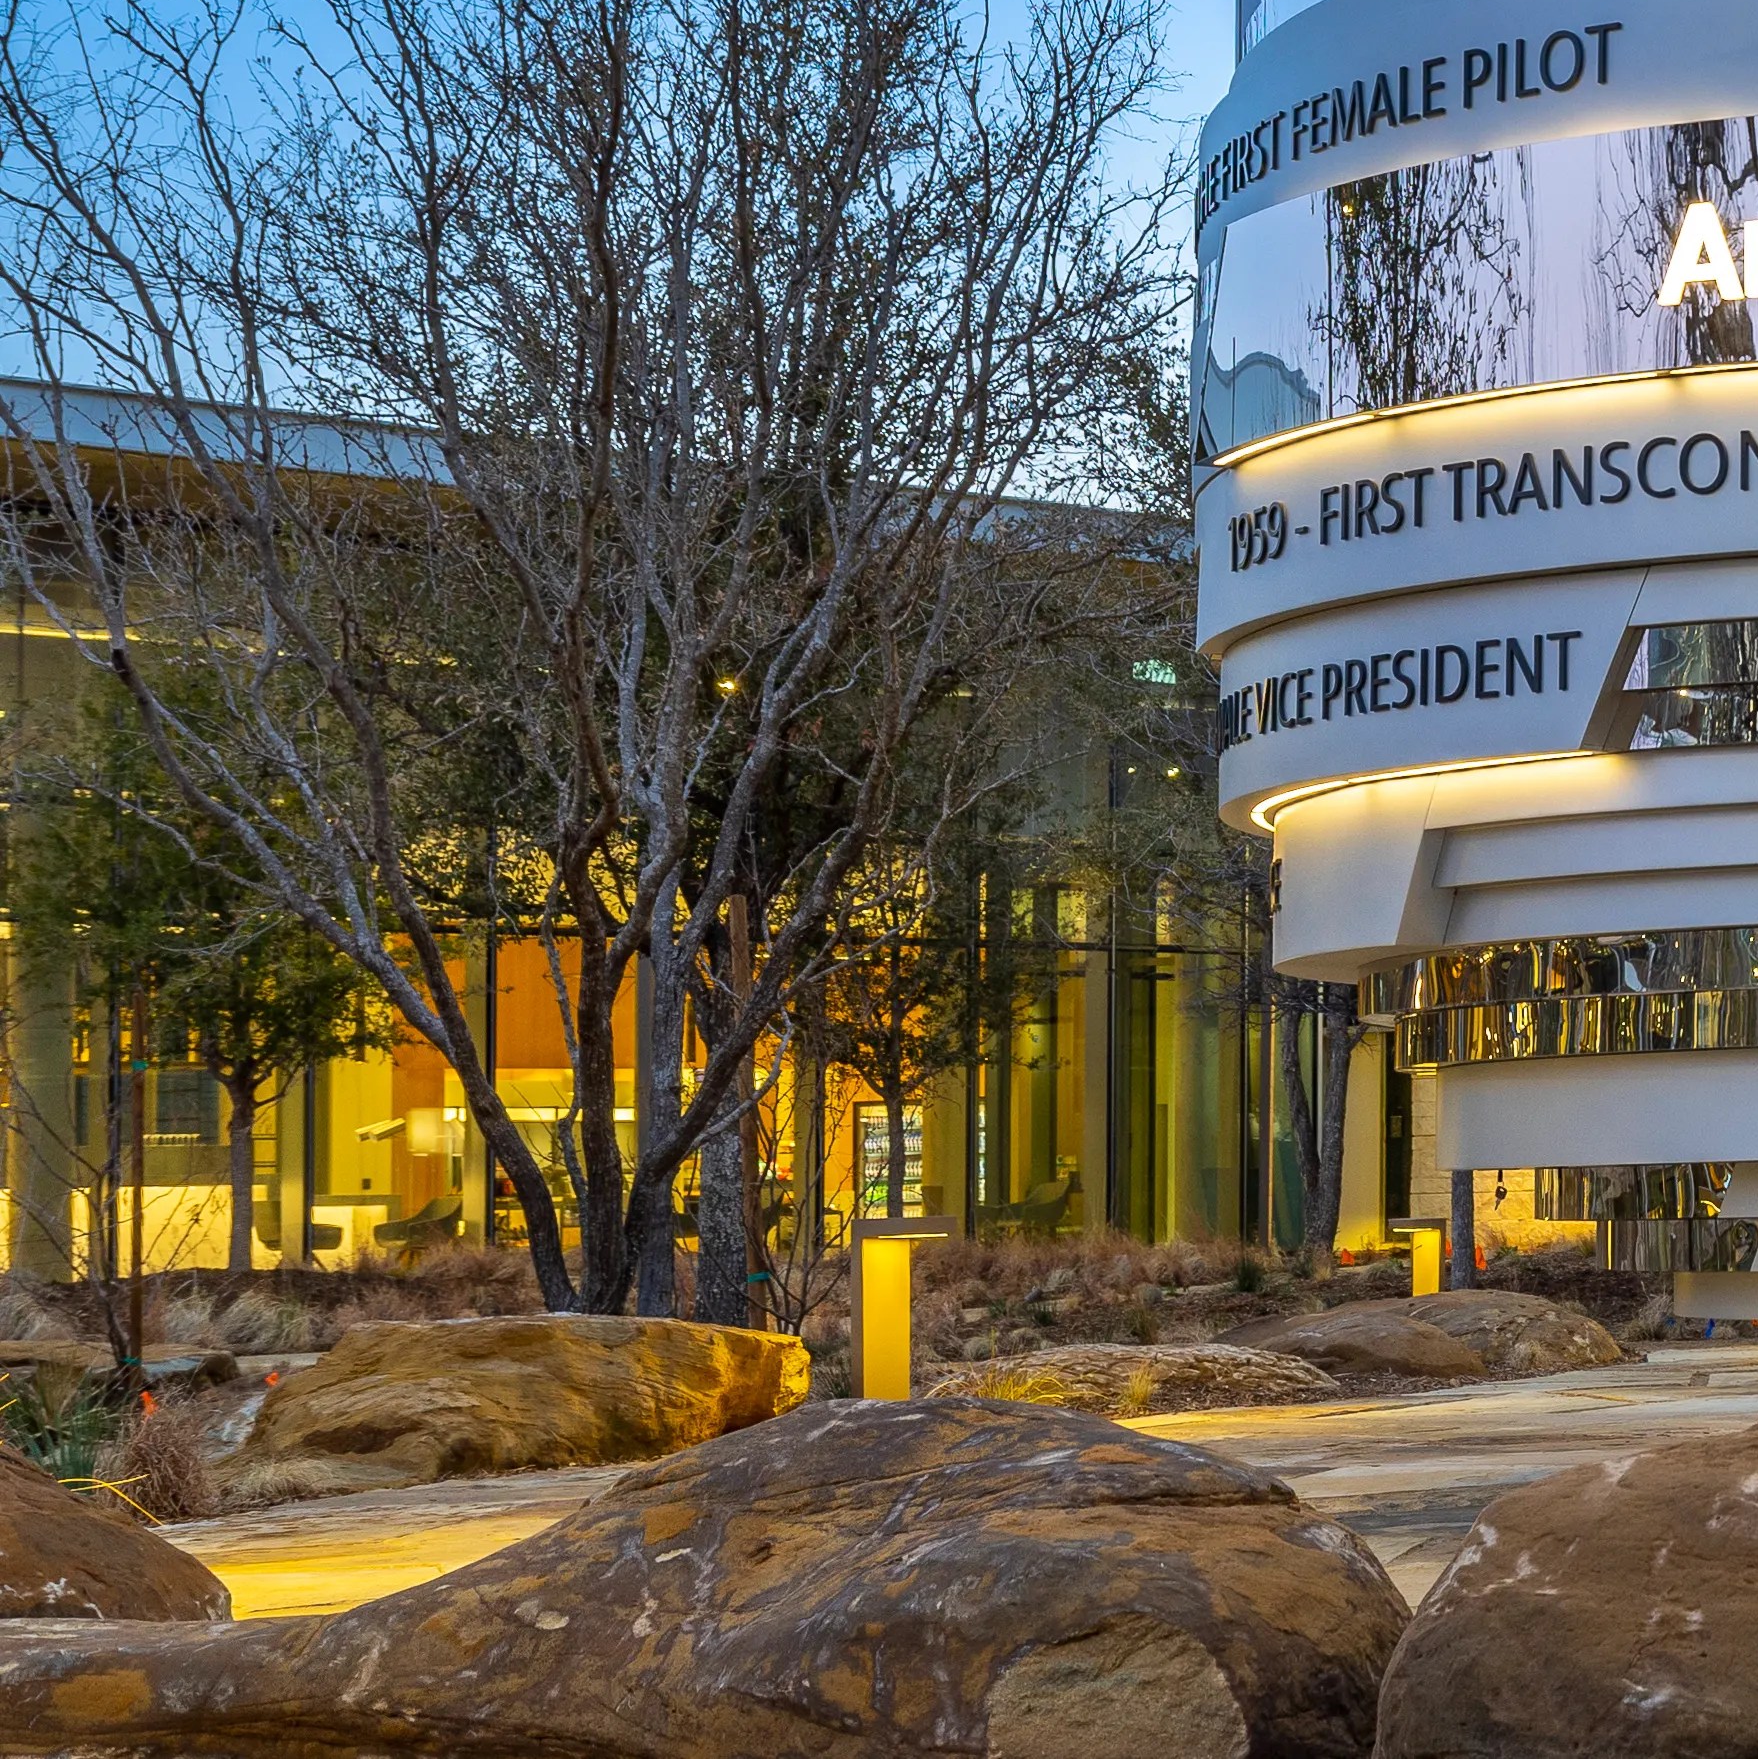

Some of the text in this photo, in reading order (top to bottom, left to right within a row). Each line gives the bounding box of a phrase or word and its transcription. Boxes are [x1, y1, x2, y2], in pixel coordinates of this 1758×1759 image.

[1221, 110, 1287, 201] FIRST
[1291, 57, 1448, 162] FEMALE
[1462, 21, 1624, 111] PILOT
[1227, 501, 1288, 574] 1959
[1294, 525, 1312, 536] -
[1319, 466, 1436, 547] FIRST
[1254, 667, 1317, 736] VICE
[1321, 630, 1584, 722] PRESIDENT
